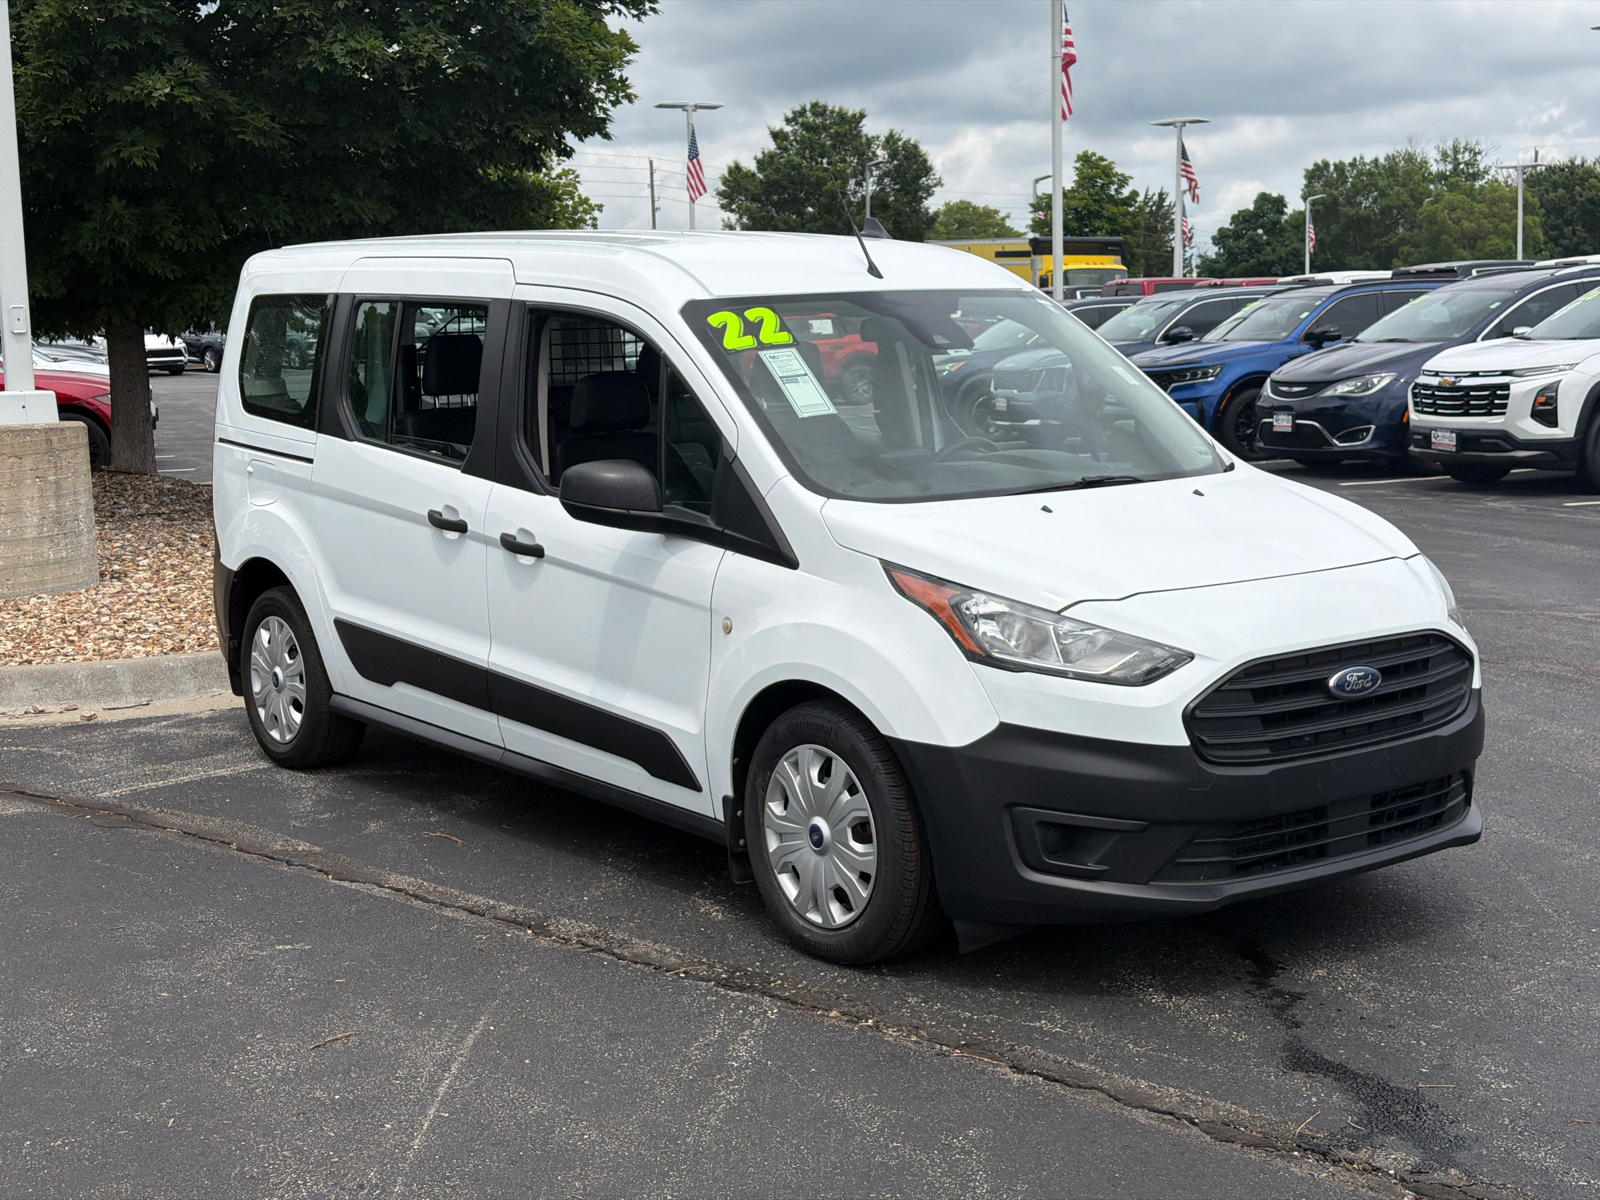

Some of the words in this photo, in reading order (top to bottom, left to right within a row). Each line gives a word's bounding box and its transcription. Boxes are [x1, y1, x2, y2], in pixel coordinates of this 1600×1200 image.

[707, 307, 793, 351] 22
[1345, 671, 1373, 691] Ford
[787, 718, 833, 738] Continental
